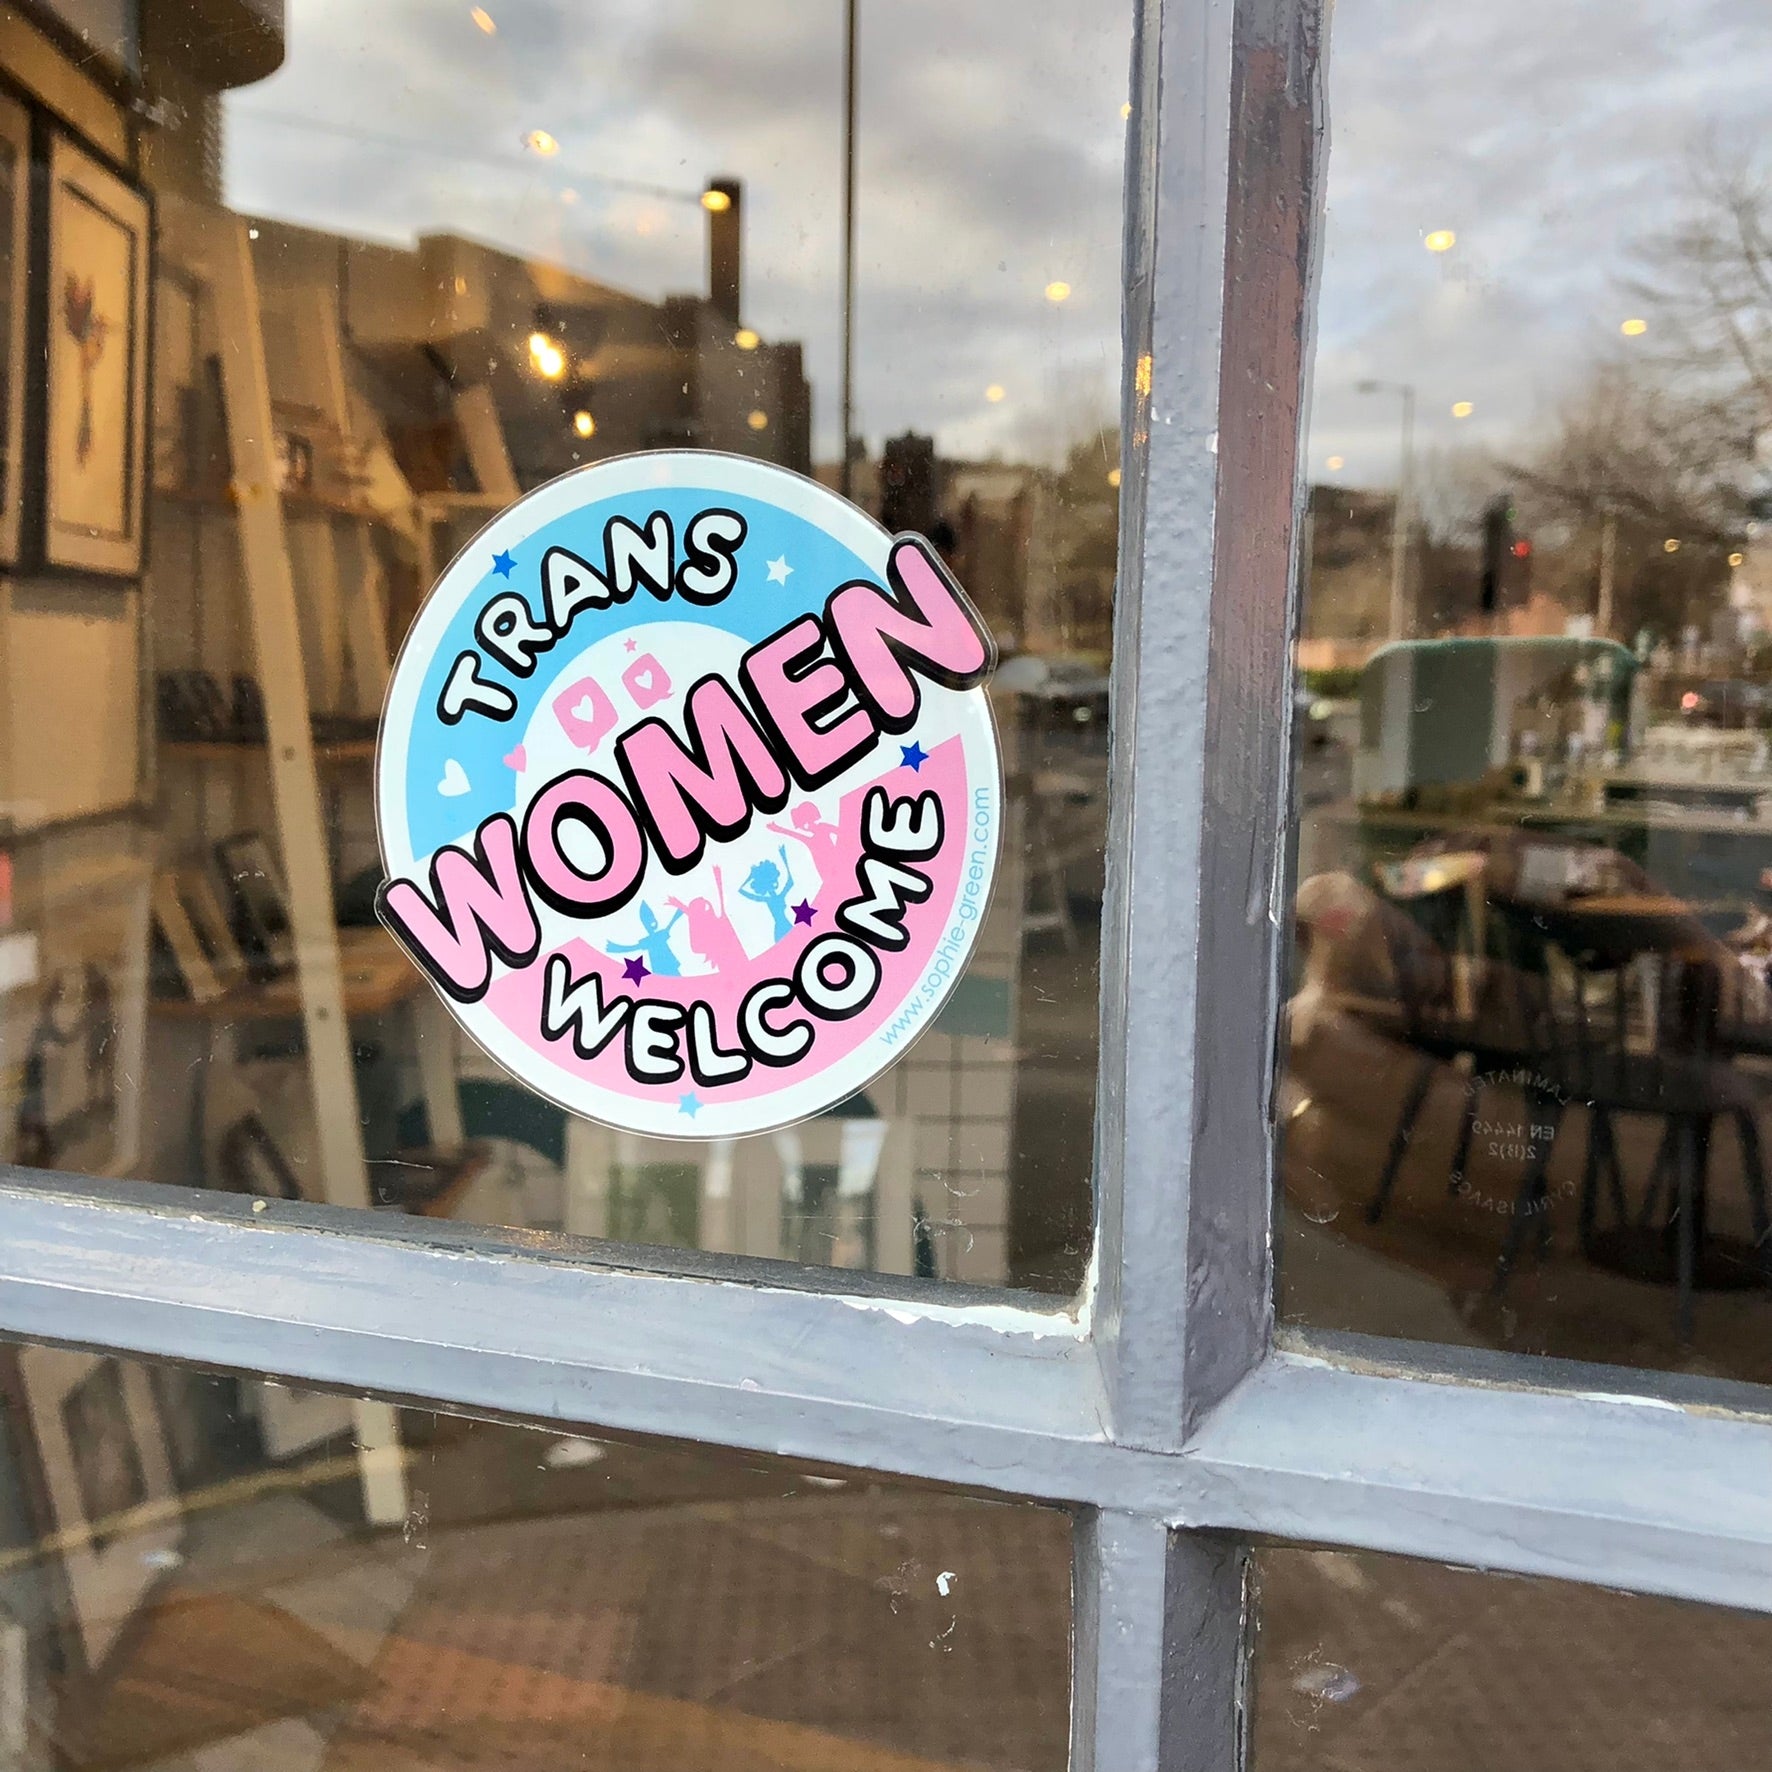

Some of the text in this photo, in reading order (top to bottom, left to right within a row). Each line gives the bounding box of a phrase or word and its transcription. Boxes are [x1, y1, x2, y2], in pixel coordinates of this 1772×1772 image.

[437, 508, 748, 726] TRANS
[379, 540, 991, 1004] WOMEN
[541, 786, 945, 1088] WELCOME
[879, 786, 990, 1046] www.sophie-green.com
